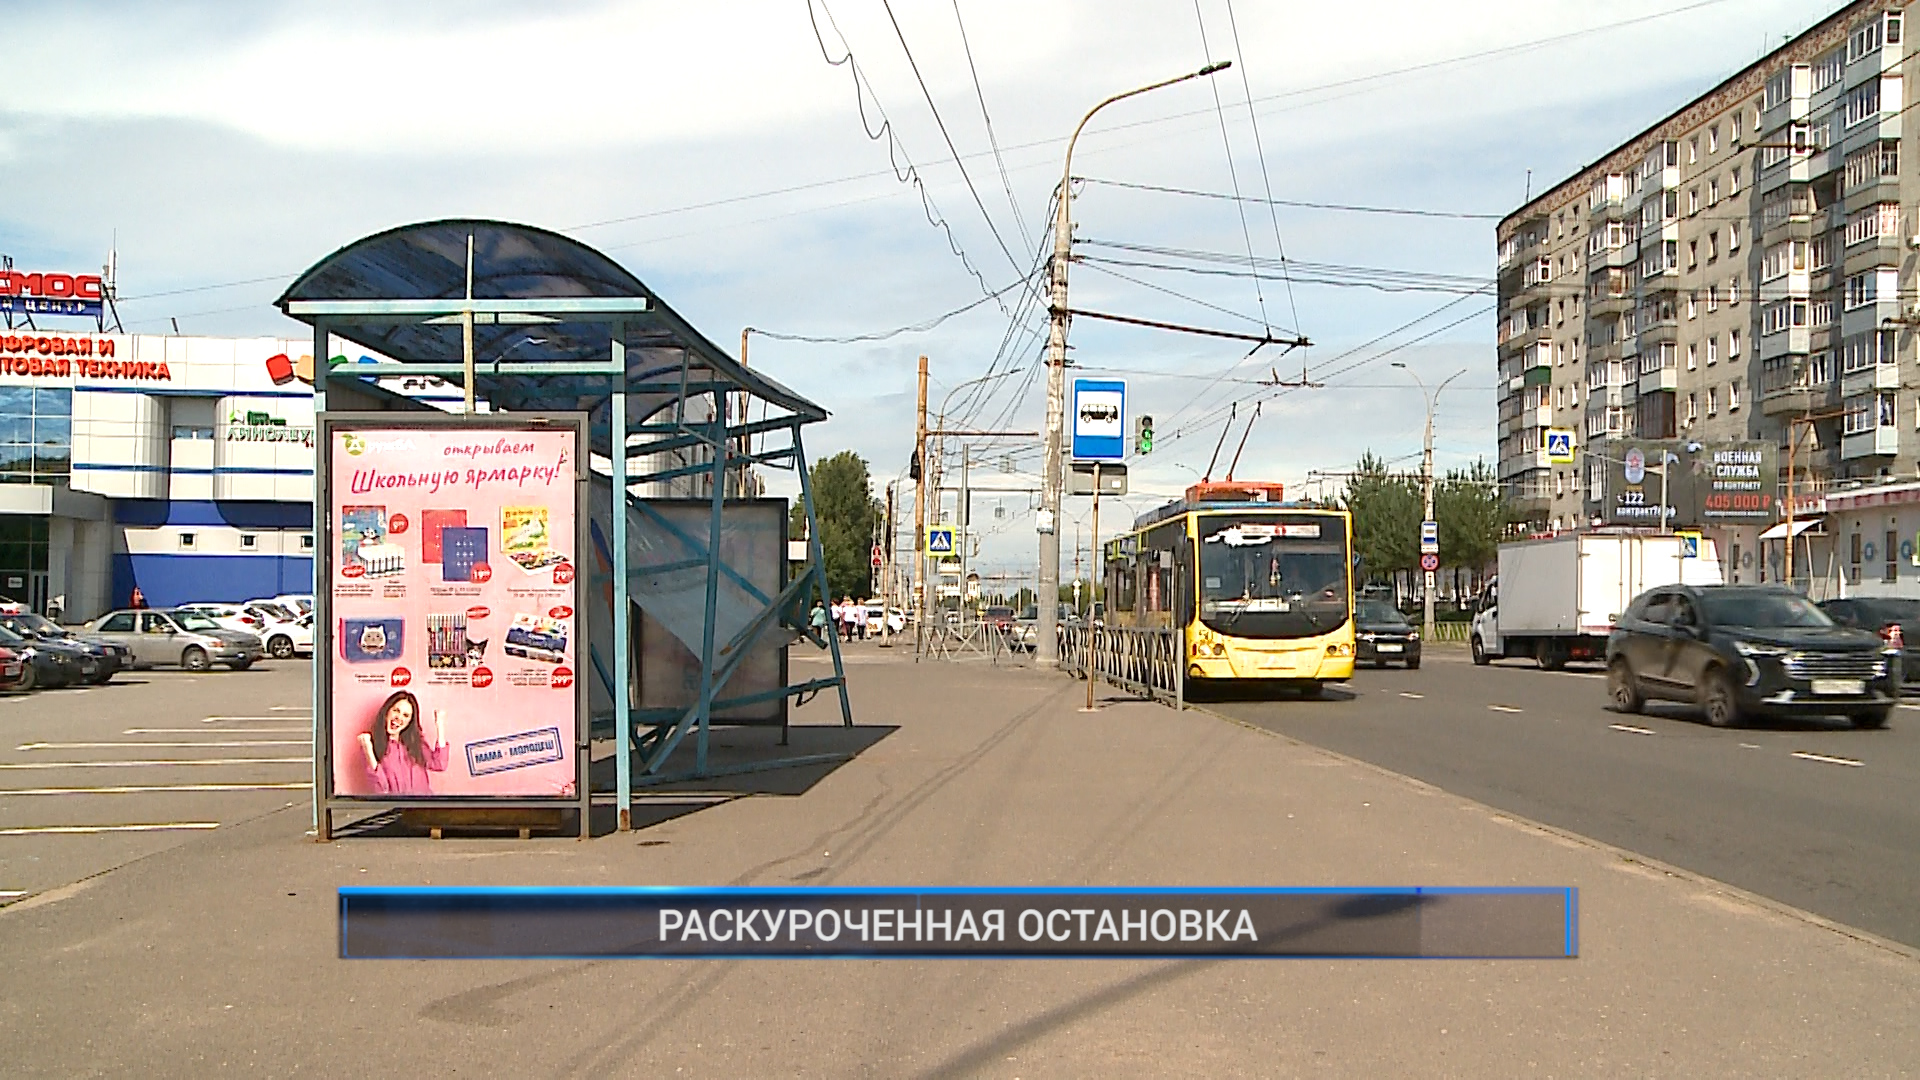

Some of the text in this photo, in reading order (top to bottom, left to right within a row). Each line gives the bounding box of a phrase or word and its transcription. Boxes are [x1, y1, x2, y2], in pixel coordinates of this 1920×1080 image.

[98, 338, 115, 358] И
[75, 359, 171, 381] ТЕХНИКА
[227, 427, 314, 443] ЛИНОЛЕУ
[443, 438, 535, 459] открываем
[1714, 451, 1762, 464] ВОЕННАЯ
[1716, 465, 1760, 477] СЛУЖБА
[351, 469, 459, 494] Школьную
[1624, 491, 1644, 504] 122
[1705, 494, 1730, 509] 405
[1734, 494, 1760, 509] 000
